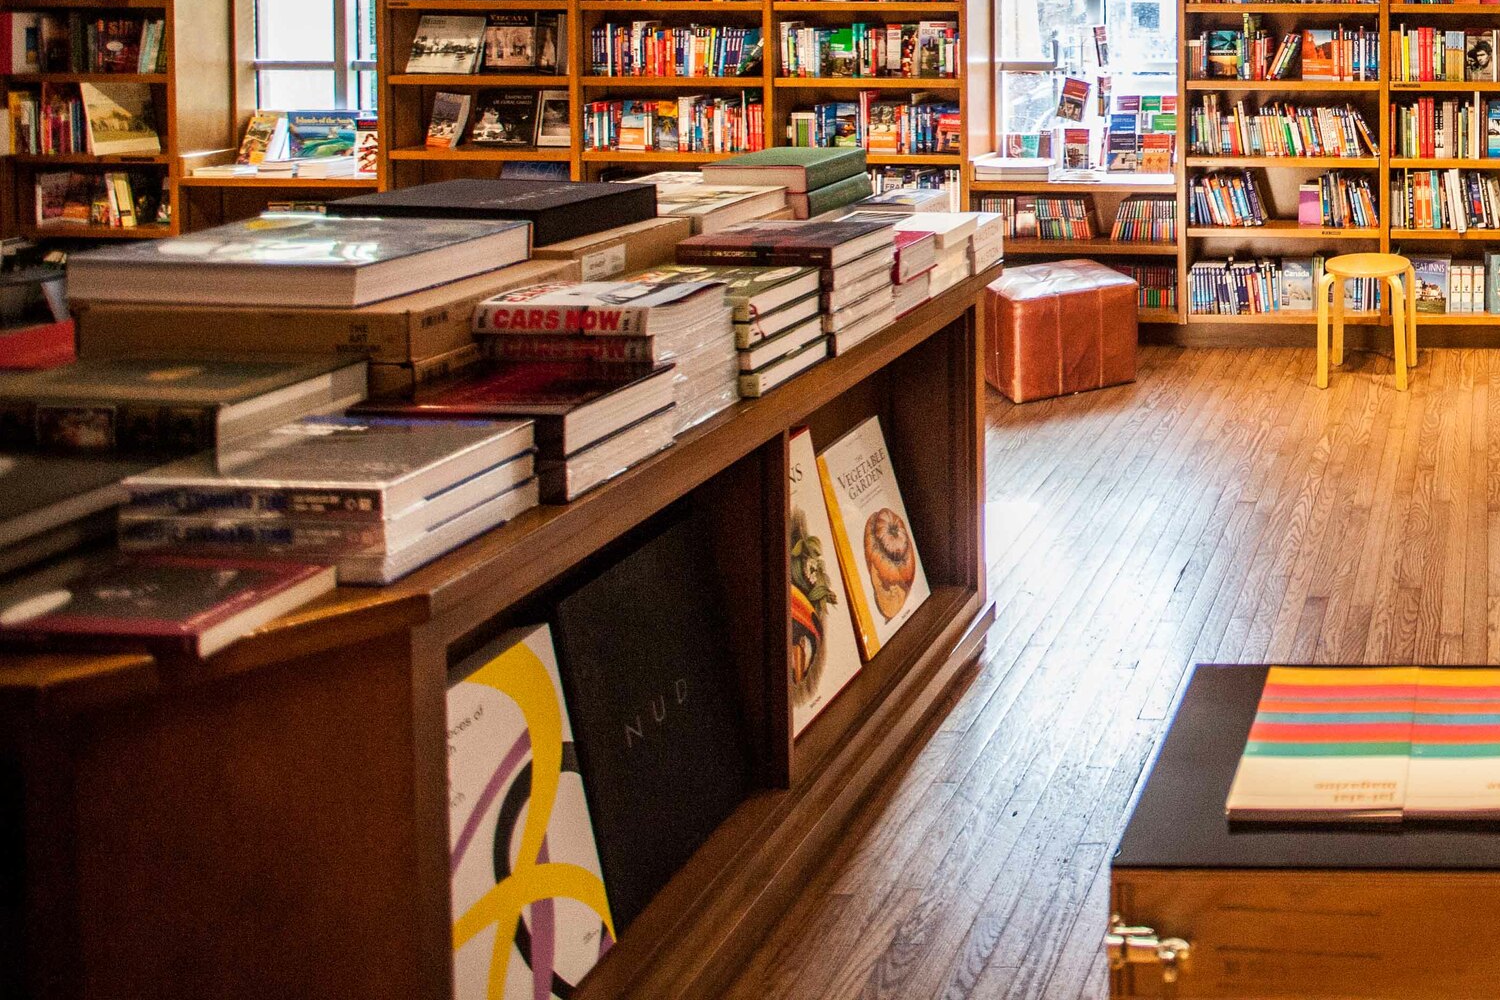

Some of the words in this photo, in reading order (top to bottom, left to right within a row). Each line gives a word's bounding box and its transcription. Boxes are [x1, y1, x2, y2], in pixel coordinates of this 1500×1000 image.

[490, 14, 529, 22] VIZCAYA
[296, 116, 317, 124] Islands
[1284, 269, 1310, 277] Canada
[1428, 262, 1445, 273] INNS
[493, 309, 561, 331] CARS
[565, 309, 622, 331] NOW
[837, 447, 886, 490] VEGETABLE
[848, 466, 884, 501] GARDEN
[1314, 780, 1397, 791] magazine
